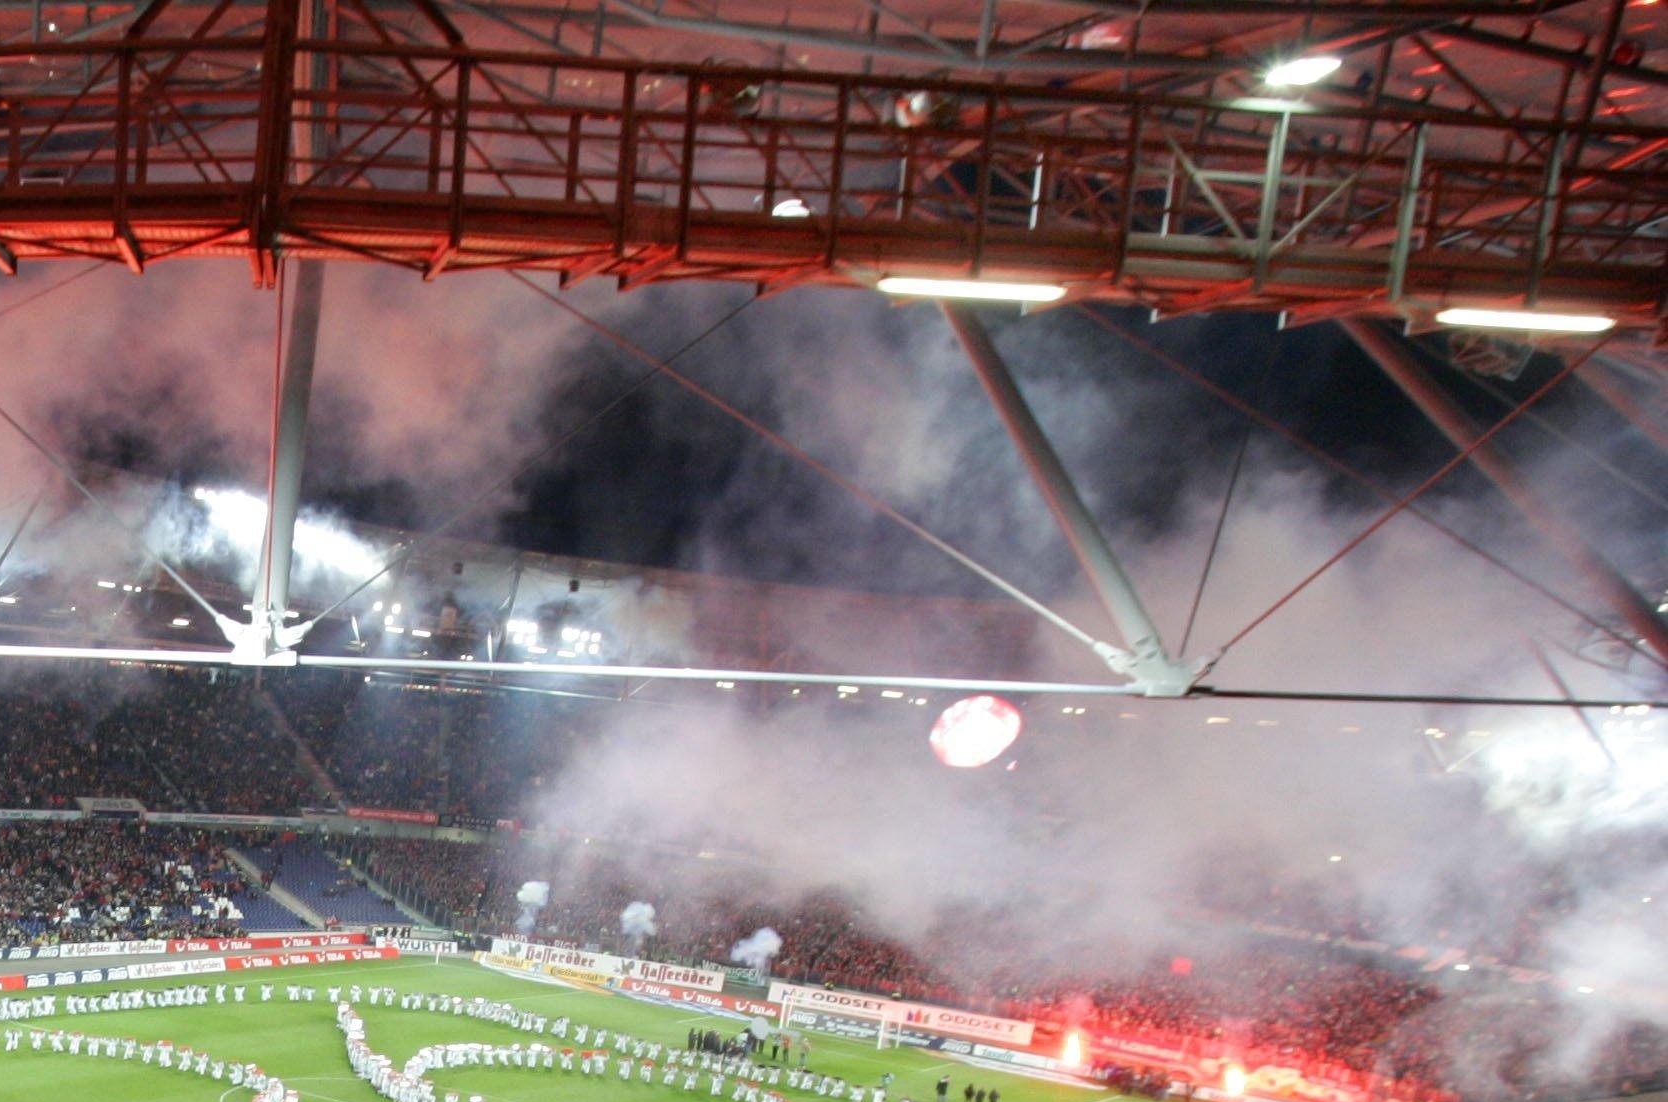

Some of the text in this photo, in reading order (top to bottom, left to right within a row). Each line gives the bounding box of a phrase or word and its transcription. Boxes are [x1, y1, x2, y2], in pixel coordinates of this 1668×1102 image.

[188, 936, 349, 951] TUI.de TUI.de TUI.de TUI.de
[253, 949, 382, 967] TUI.de TUI.de TUI.de TUI.de
[27, 968, 129, 988] AWD AWD AWD AWD
[645, 984, 777, 1017] TUI.de TUI.de TUI.de
[812, 992, 885, 1011] ODDSET
[939, 1012, 1018, 1033] ODDSET
